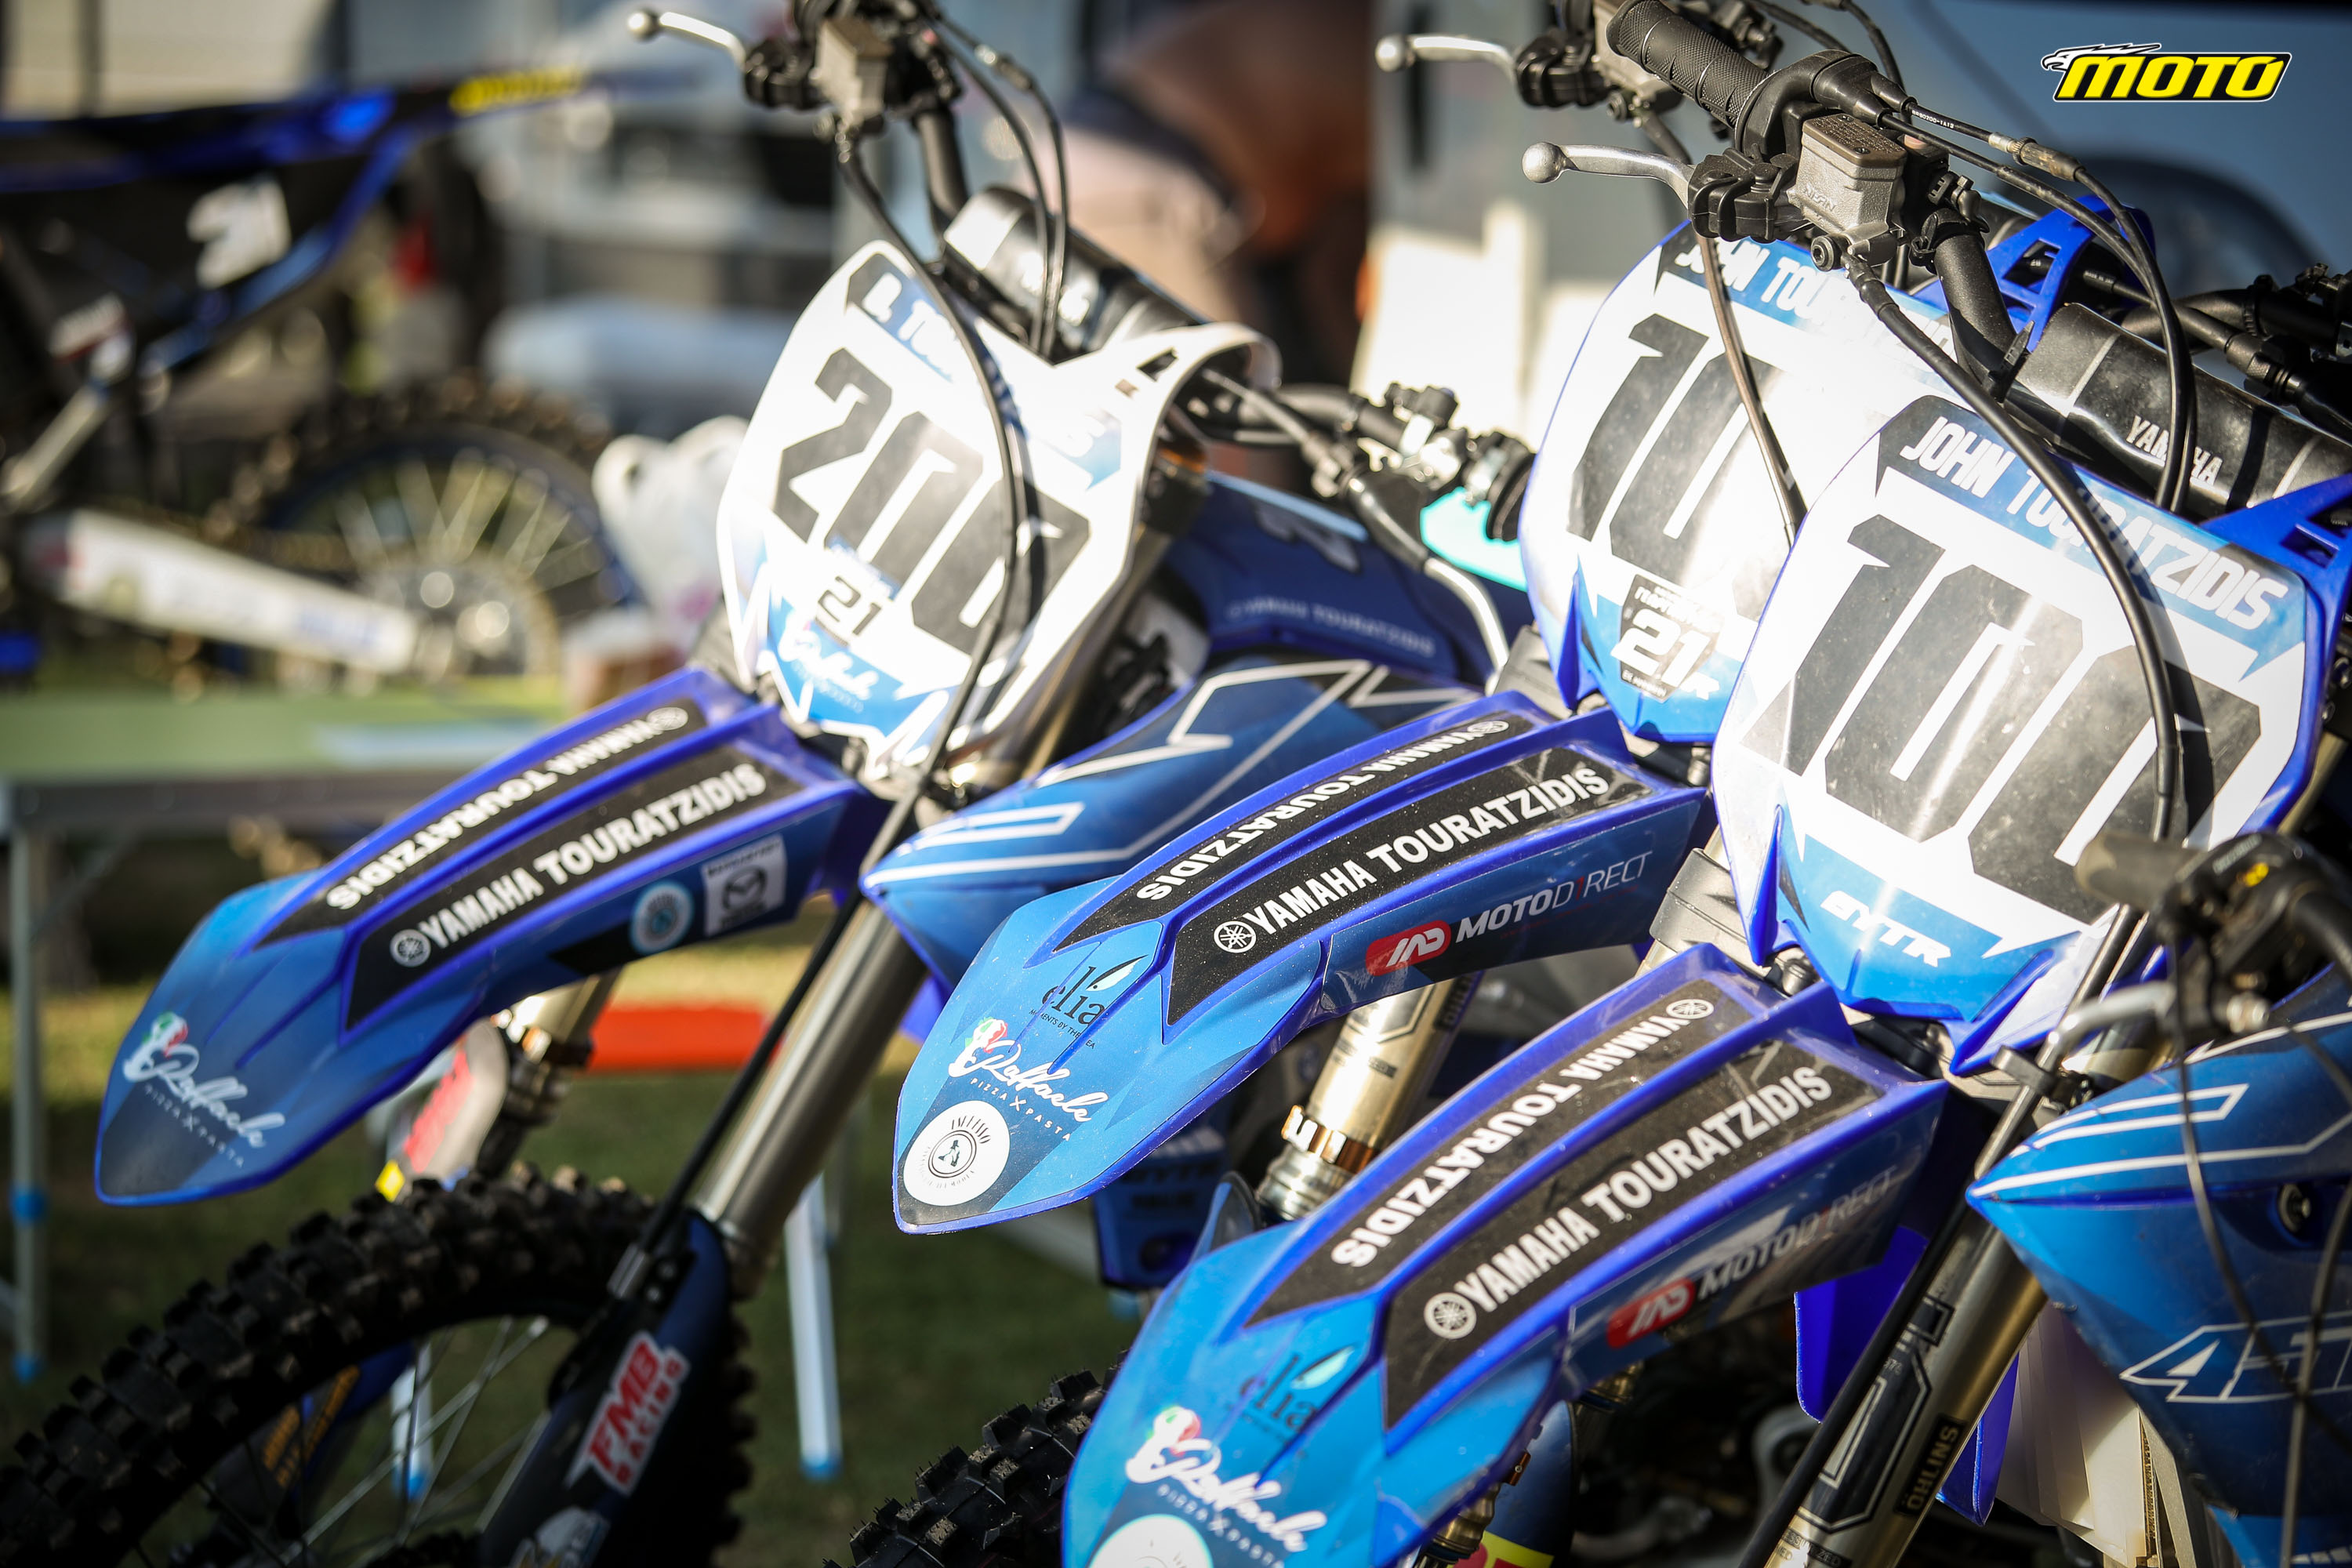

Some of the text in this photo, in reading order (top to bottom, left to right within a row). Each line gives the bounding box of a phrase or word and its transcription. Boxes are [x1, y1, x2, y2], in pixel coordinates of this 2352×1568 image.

[772, 347, 1091, 657] 200
[1899, 416, 2016, 499] JOHN
[2125, 415, 2223, 487] YAMHA
[1610, 608, 1711, 688] 21
[1739, 514, 2261, 925] 100
[326, 770, 557, 909] TOURATZIDIS
[420, 869, 543, 949] YAMAHA
[534, 763, 766, 884] TOURATZIDIS
[1137, 731, 1484, 900] YAMAHA TOURATZIDIS
[1243, 768, 1610, 935] YAMAHA TOURATZIDIS
[971, 1076, 1008, 1102] PIZZA
[1025, 1107, 1072, 1142] PASTA
[1331, 1016, 1692, 1267] YAMAHA TOURATZIDIS
[1455, 1066, 1832, 1312] YAMAHA TOURATZIDIS
